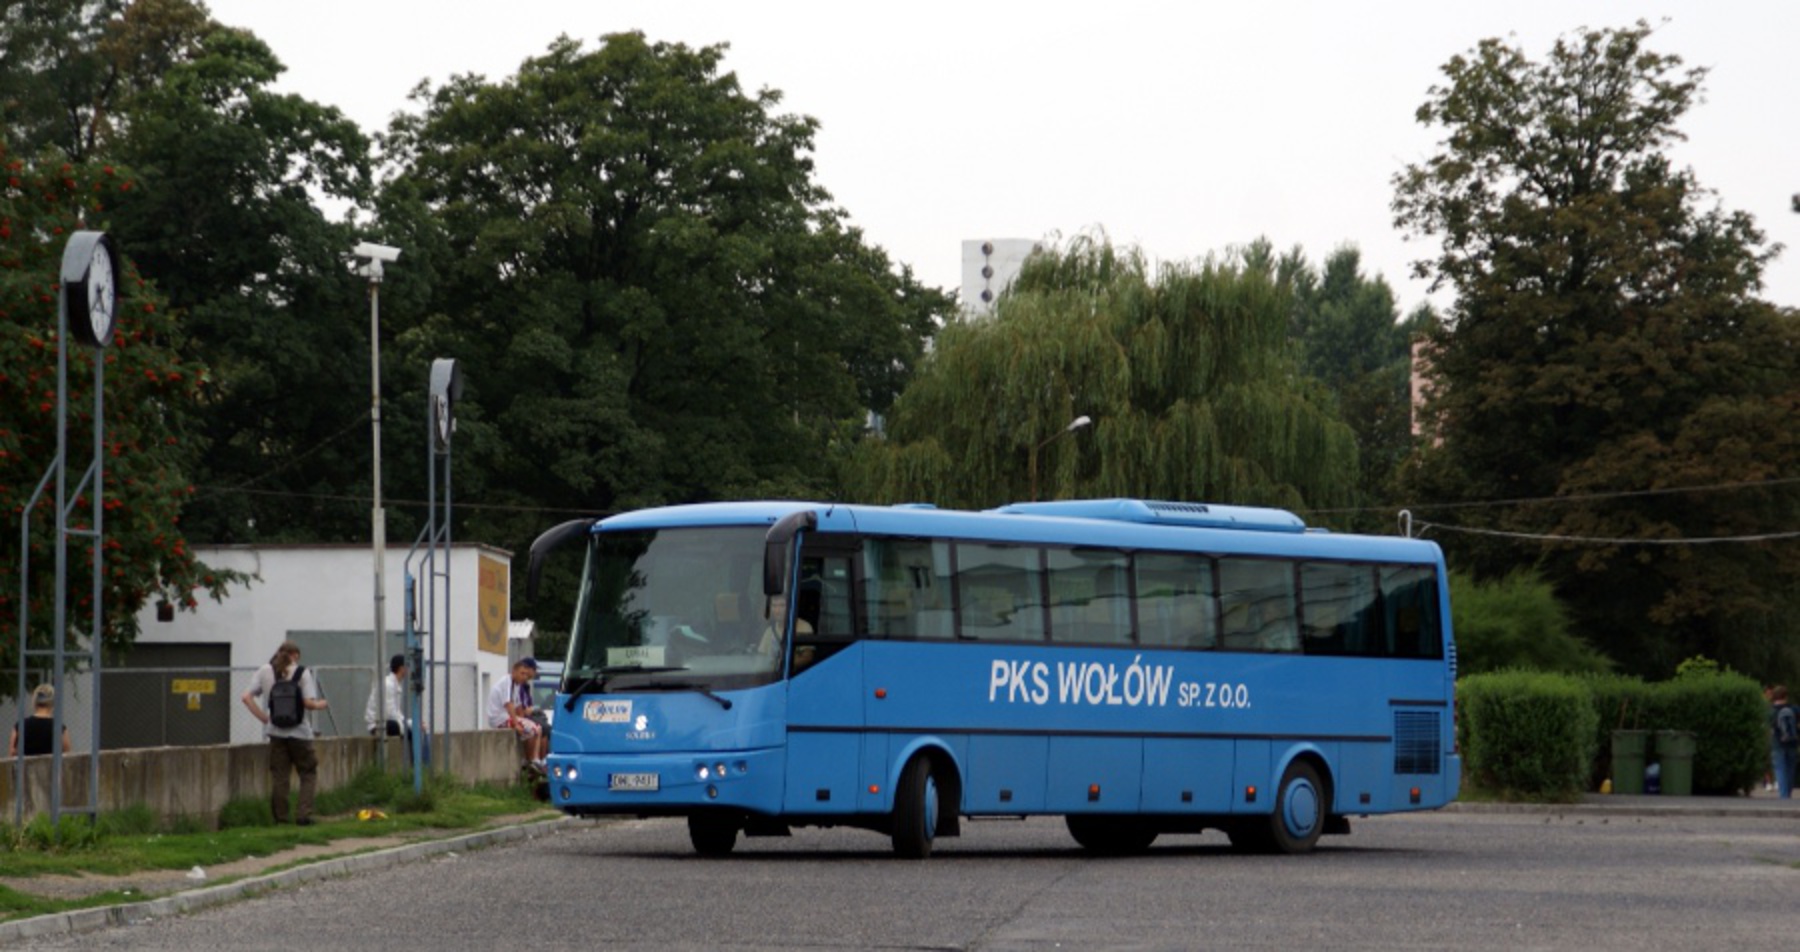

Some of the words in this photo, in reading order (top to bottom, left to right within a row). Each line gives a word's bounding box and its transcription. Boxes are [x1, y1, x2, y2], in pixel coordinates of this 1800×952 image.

[989, 660, 1049, 705] PKS
[1057, 654, 1174, 706] WOŁÓW
[1178, 682, 1201, 707] SP.
[1205, 683, 1215, 707] Z
